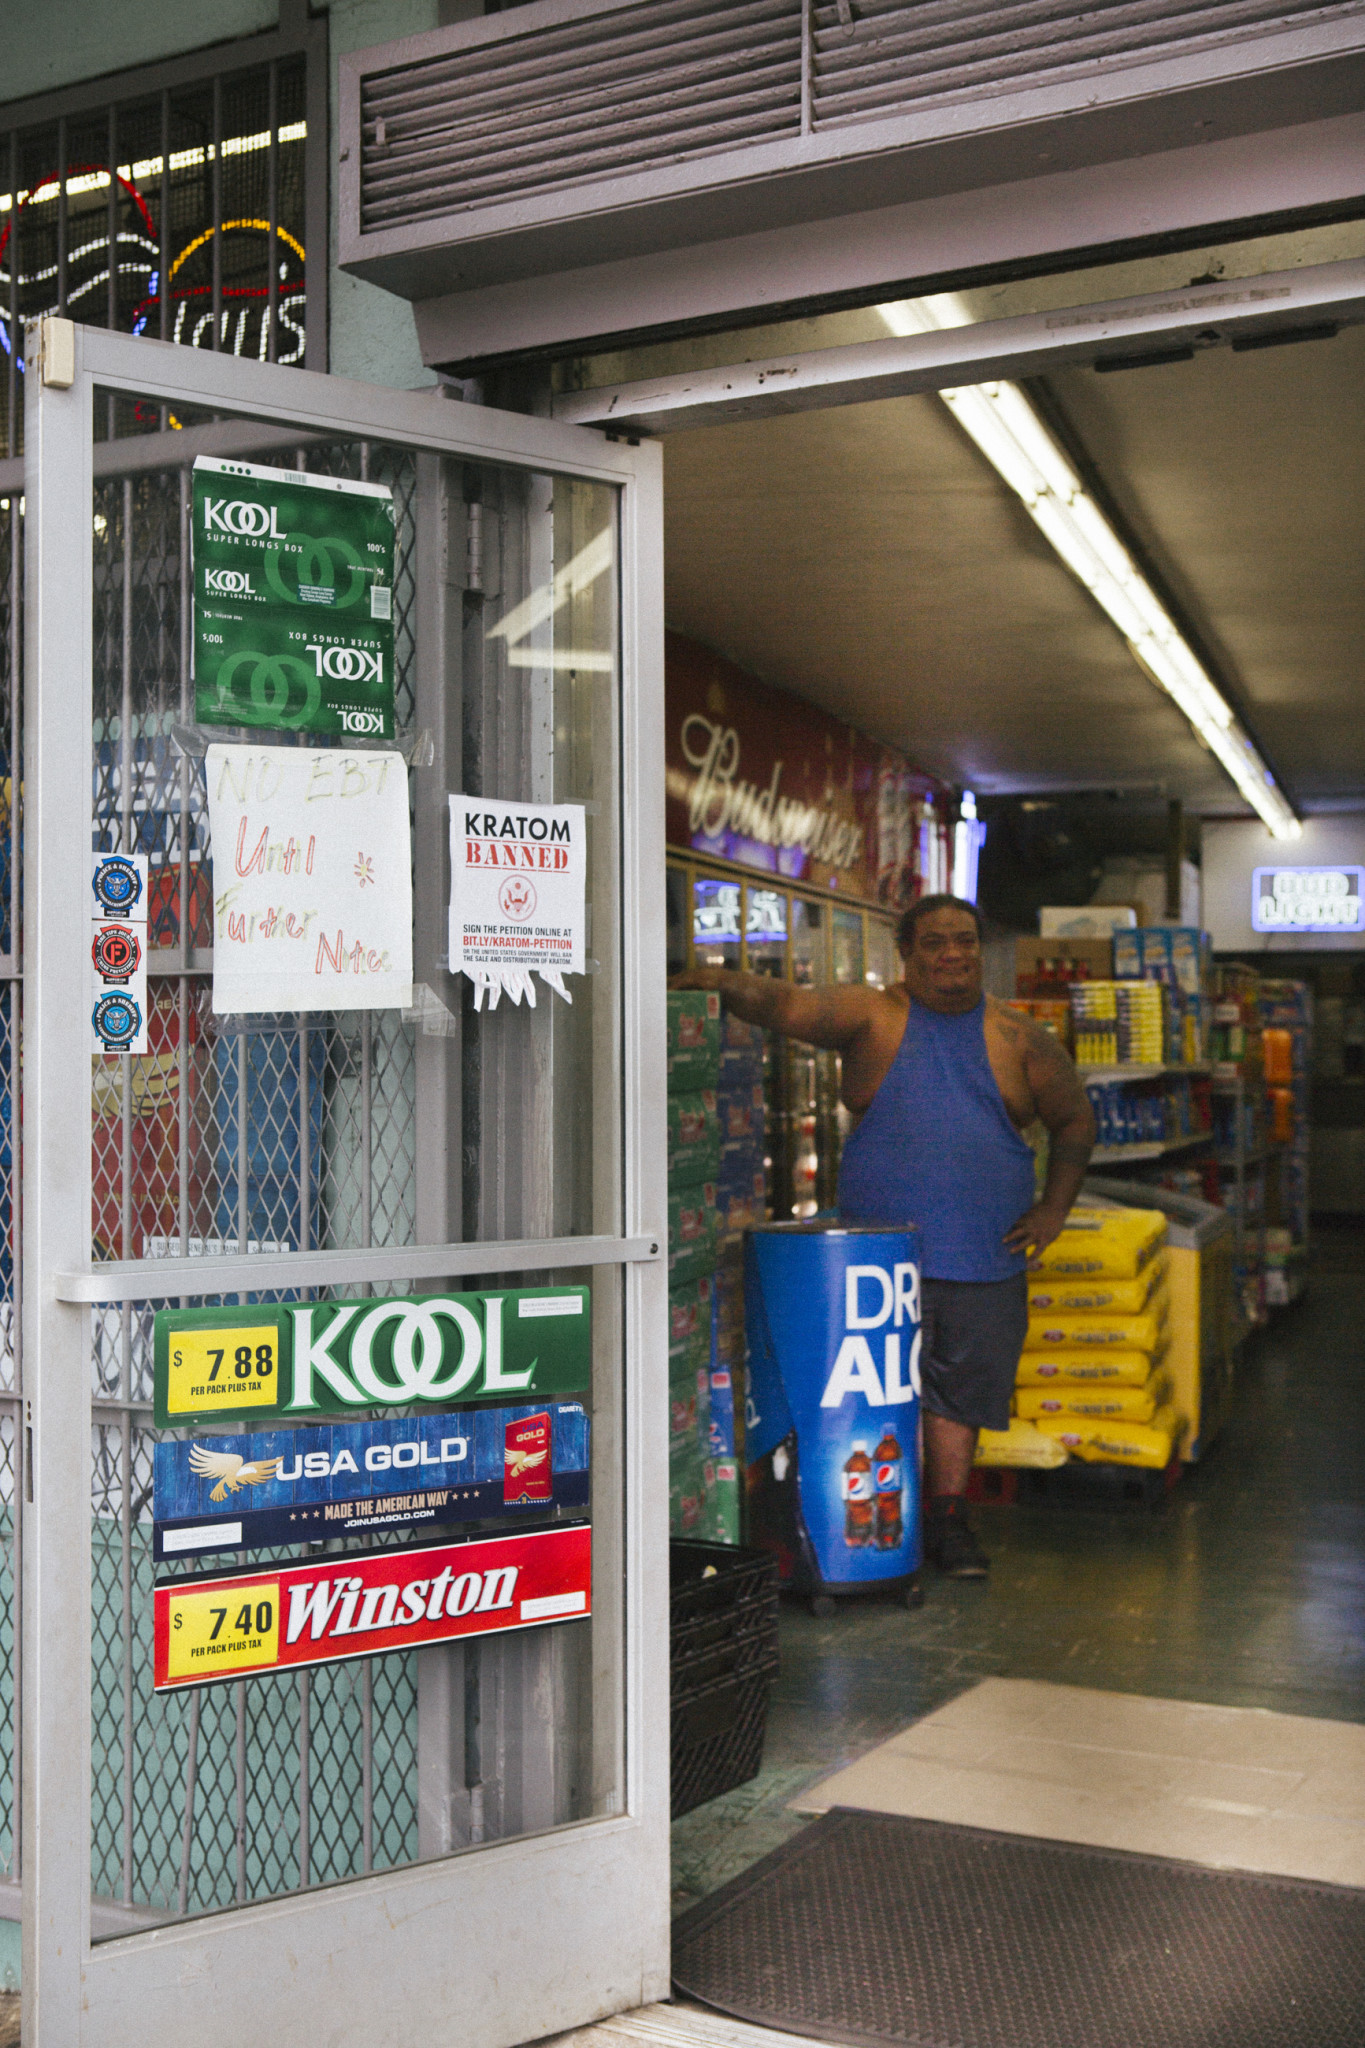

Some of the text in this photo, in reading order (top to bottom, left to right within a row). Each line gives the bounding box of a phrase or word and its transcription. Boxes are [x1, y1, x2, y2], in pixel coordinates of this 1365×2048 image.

[204, 497, 287, 539] KOOL
[206, 533, 303, 553] SUPER LONGS BOX
[367, 543, 386, 553] 100's
[205, 568, 256, 594] KOOL
[203, 633, 224, 644] 100's
[289, 632, 381, 649] SUPER LONGS BOX
[305, 645, 384, 683] KOOL
[337, 711, 384, 733] KOOL
[216, 754, 394, 803] NO EBT
[465, 813, 571, 842] KRATOM
[235, 815, 316, 877] Until
[466, 842, 569, 869] BANNED
[97, 864, 112, 882] POLICE
[118, 864, 137, 885] SHERIFF
[1260, 895, 1361, 924] LIGHT
[97, 934, 106, 946] FIRE
[118, 930, 136, 948] JOURNAL
[463, 924, 572, 937] SIGN THE PETITION ONLINE AT
[315, 929, 392, 975] Notice
[463, 936, 572, 950] BIT.LY/KRATOM-PETITION
[98, 958, 109, 971] CRIME
[96, 998, 112, 1018] POLICE
[118, 998, 137, 1018] SHERIFF
[173, 1350, 182, 1368] $
[288, 1298, 536, 1409] KOOL
[191, 1381, 262, 1396] PER PACK PLUS TAX
[516, 1429, 545, 1442] GOLD
[522, 1421, 544, 1432] USA
[276, 1437, 468, 1481] USA GOLD
[325, 1491, 449, 1520] MADE THE AMERICAN WAY
[344, 1510, 435, 1528] JOINUSAGOLD.COM
[286, 1565, 519, 1645] Winston
[174, 1613, 182, 1631] $
[191, 1639, 262, 1657] PER PACK PLUS TAX
